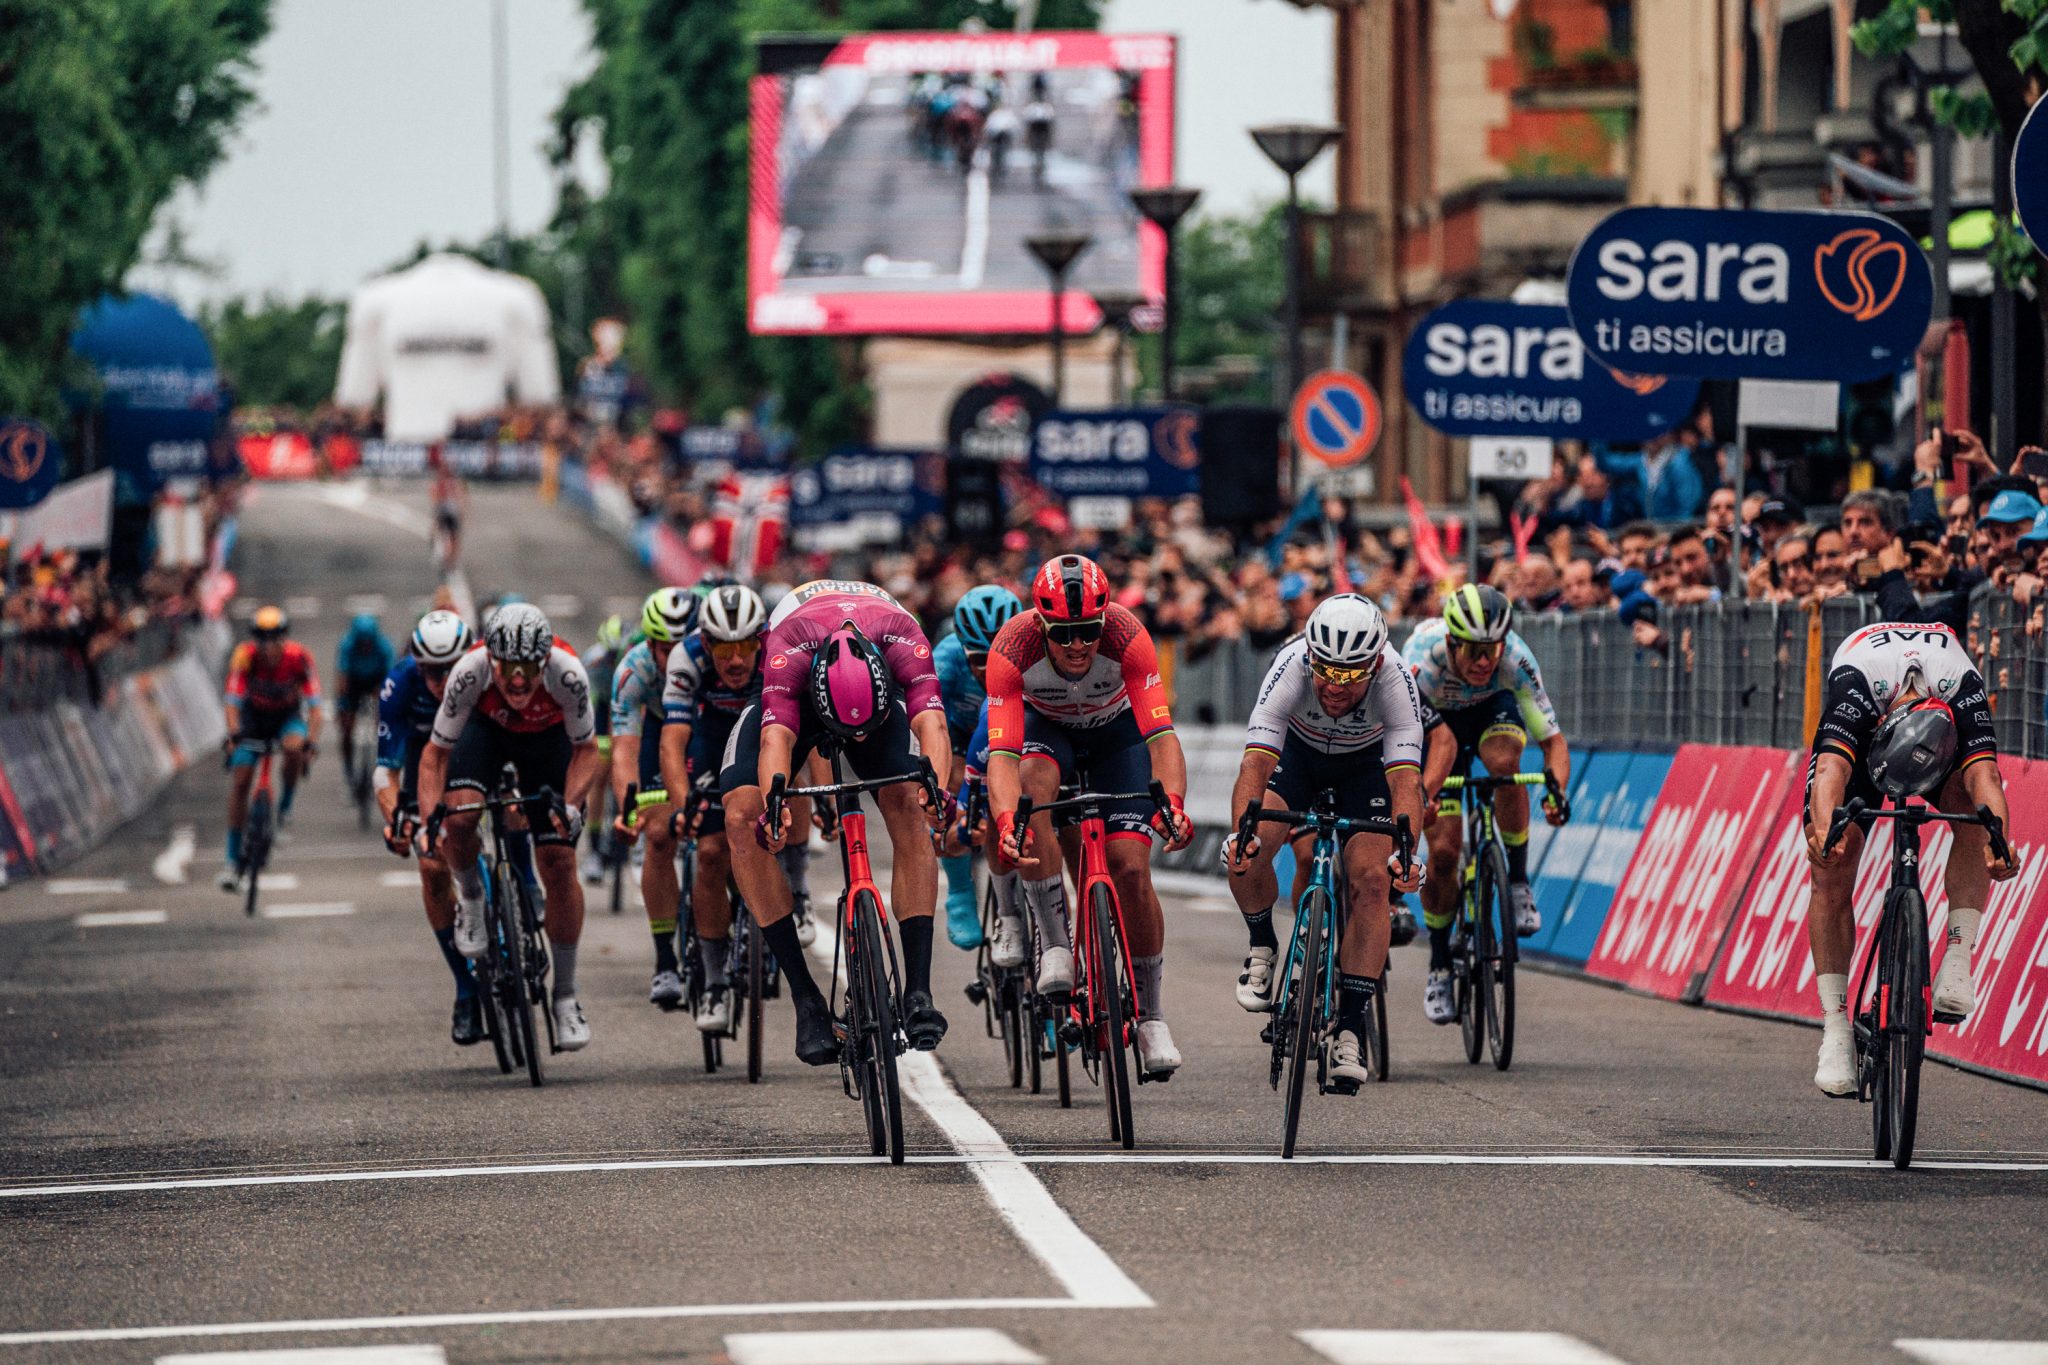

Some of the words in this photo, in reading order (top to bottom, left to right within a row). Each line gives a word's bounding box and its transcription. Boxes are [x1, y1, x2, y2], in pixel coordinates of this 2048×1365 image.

[1595, 237, 1790, 303] sara
[1424, 322, 1586, 381] sara
[1593, 317, 1621, 351] ti
[1628, 320, 1787, 357] assicura
[1424, 387, 1449, 418] ti
[1451, 388, 1583, 424] assicura
[1037, 418, 1149, 462] sara
[1494, 447, 1528, 473] 50
[1868, 630, 1949, 650] UAE
[818, 659, 834, 720] RUDY
[1259, 652, 1296, 705] QAZAQSTAN
[1396, 662, 1421, 723] QAZAQSTAN
[1108, 812, 1144, 822] Santini
[1120, 820, 1155, 838] TR
